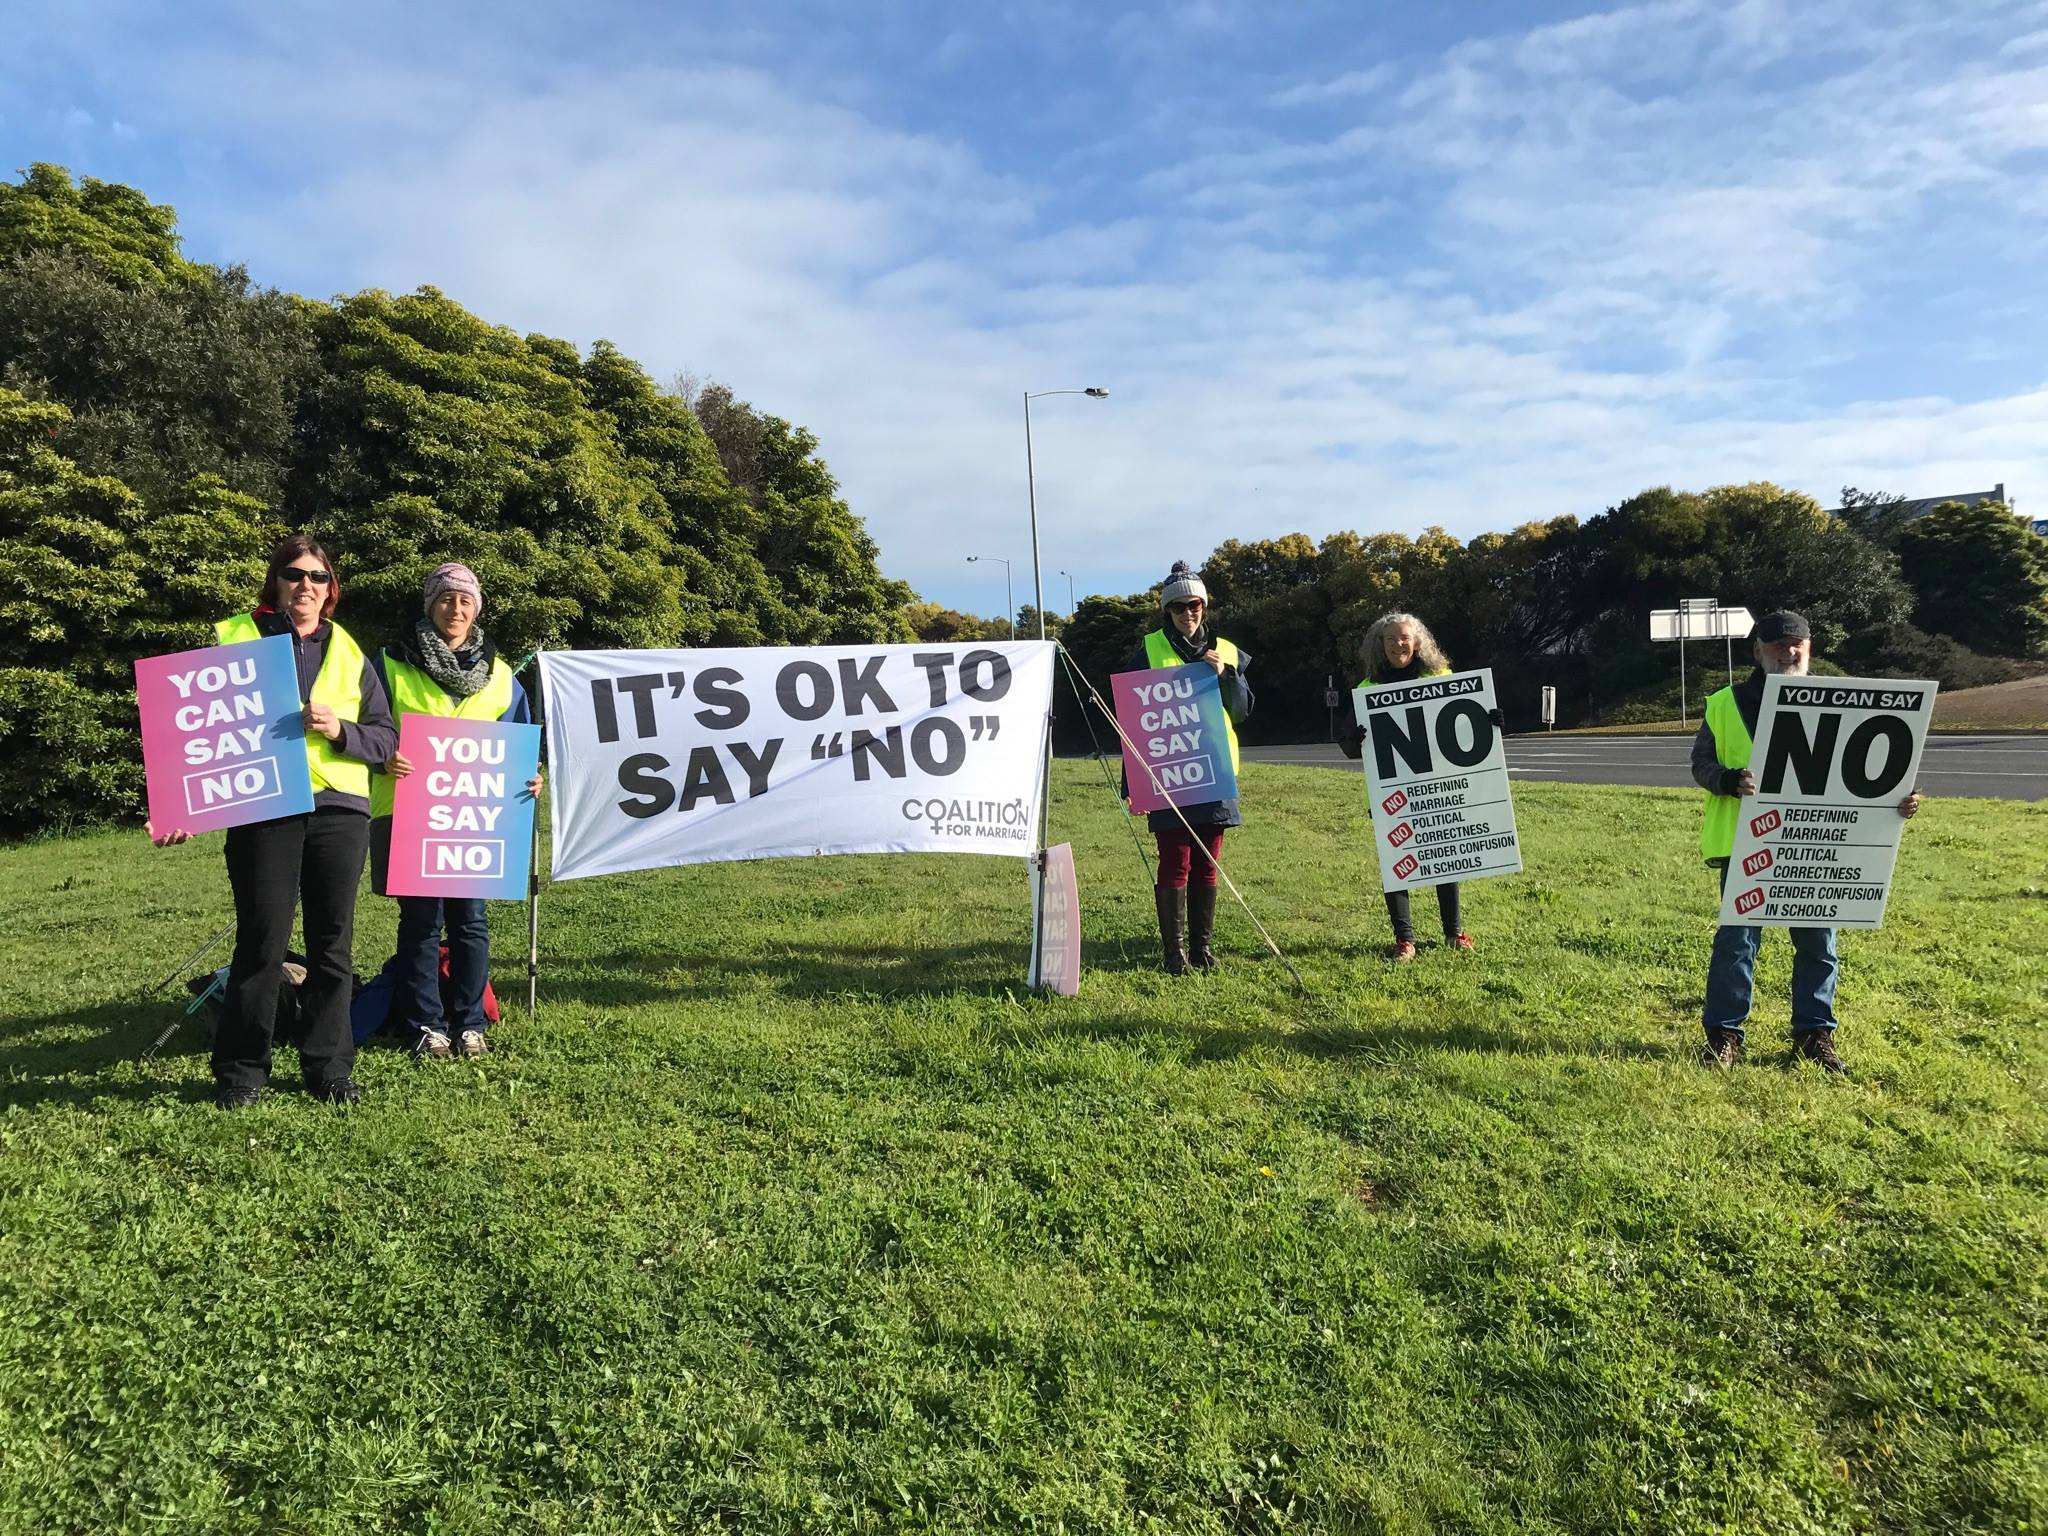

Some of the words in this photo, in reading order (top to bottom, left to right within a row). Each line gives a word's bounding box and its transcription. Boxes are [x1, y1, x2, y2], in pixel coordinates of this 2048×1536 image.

[167, 658, 257, 698] YOU
[591, 666, 750, 743] IT’S
[775, 655, 899, 721] OK
[913, 649, 1012, 708] TO
[1133, 677, 1194, 706] YOU
[1370, 692, 1404, 707] YOU
[1409, 685, 1444, 700] CAN
[1449, 679, 1479, 693] SAY
[1784, 688, 1825, 704] YOU
[1831, 691, 1874, 707] CAN
[1879, 693, 1919, 709] SAY
[175, 690, 265, 732] CAN
[1140, 704, 1200, 732] CAN
[184, 724, 266, 765] SAY
[427, 736, 506, 764] YOU
[1148, 729, 1202, 758] SAY
[1369, 698, 1494, 780] NO
[617, 738, 784, 819] SAY
[810, 715, 1001, 782] “NO”
[1759, 711, 1914, 799] NO
[201, 767, 266, 805] NO
[426, 771, 505, 797] CAN
[1161, 762, 1204, 788] NO
[1406, 778, 1469, 798] REDEFINING
[902, 798, 1029, 829] COALITION
[1385, 794, 1404, 813] NO
[1410, 794, 1465, 813] MARRIAGE
[1784, 808, 1858, 823] REDEFINING
[427, 805, 503, 832] SAY
[1412, 811, 1466, 830] POLITICAL
[1755, 814, 1776, 834] NO
[946, 824, 972, 836] FOR
[975, 825, 1027, 840] MARRIAGE
[1391, 826, 1409, 845] NO
[1414, 822, 1490, 845] CORRECTNESS
[1781, 827, 1848, 842] MARRIAGE
[437, 845, 492, 871] NO
[1417, 845, 1457, 861] GENDER
[1459, 835, 1515, 854] CONFUSION
[1776, 847, 1839, 862] POLITICAL
[1396, 859, 1414, 877] NO
[1420, 864, 1431, 877] IN
[1434, 856, 1482, 874] SCHOOLS
[1747, 853, 1768, 873] NO
[1773, 865, 1862, 880] CORRECTNESS
[1739, 892, 1760, 912] NO
[1769, 885, 1815, 899] GENDER
[1818, 887, 1883, 901] CONFUSION
[1765, 903, 1778, 916] IN
[1780, 904, 1838, 918] SCHOOLS
